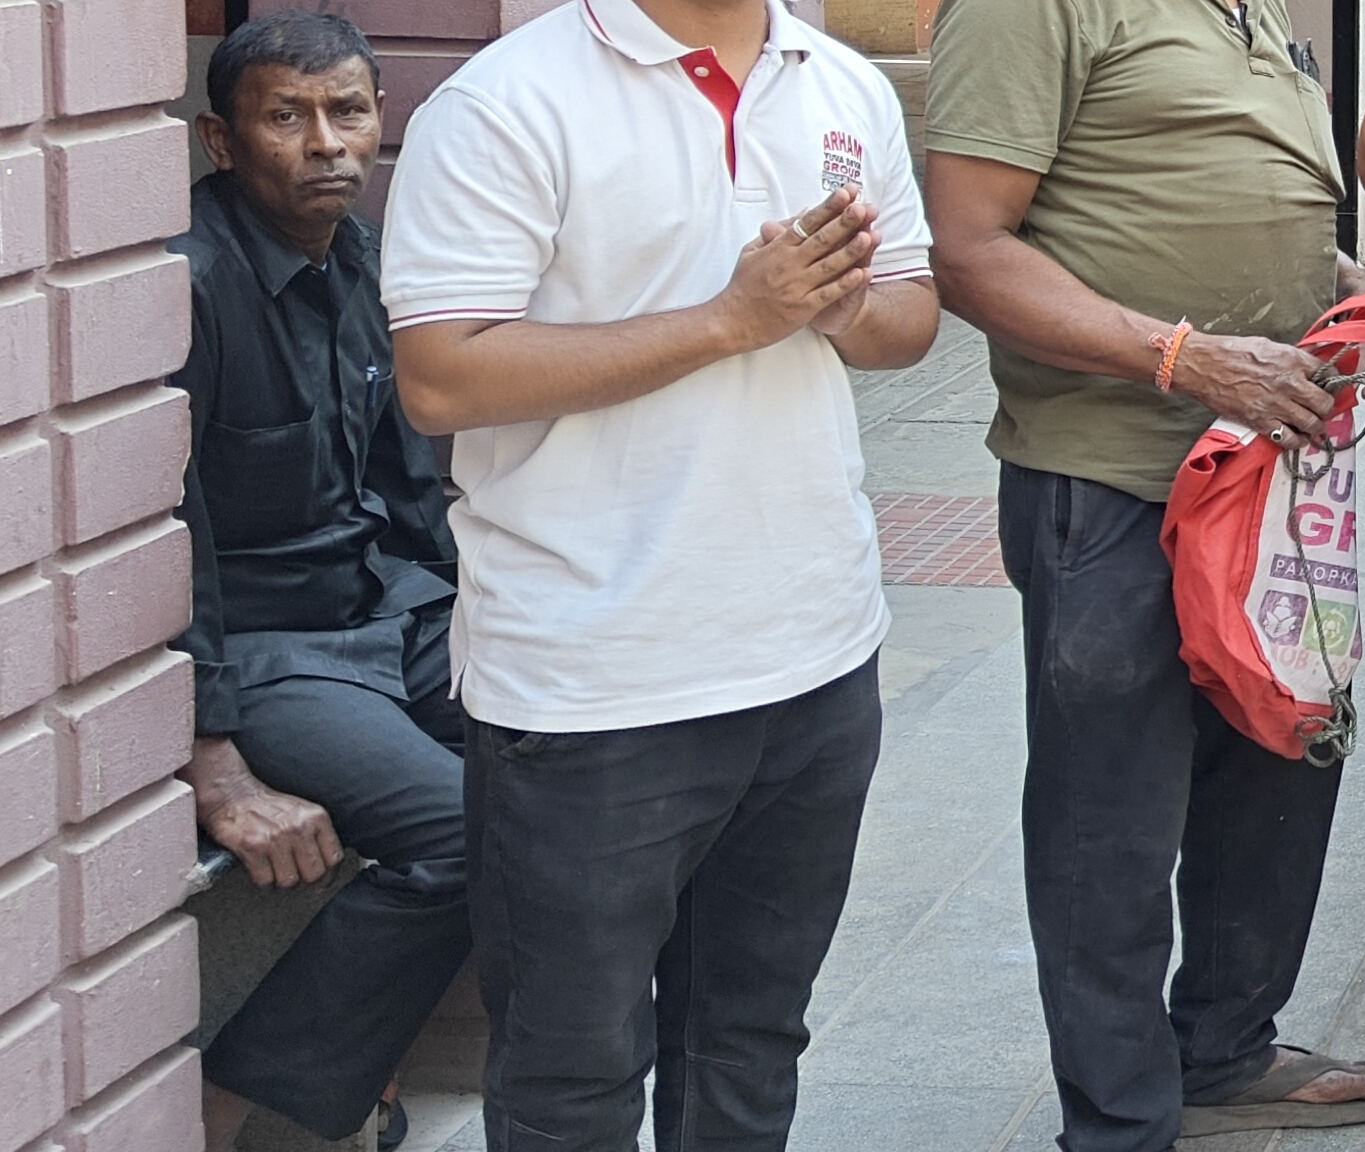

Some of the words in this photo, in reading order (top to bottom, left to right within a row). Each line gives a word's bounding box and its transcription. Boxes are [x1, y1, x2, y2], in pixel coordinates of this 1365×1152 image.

[823, 131, 863, 161] ARHAM
[823, 160, 861, 179] GROUP
[1301, 461, 1355, 503] YU
